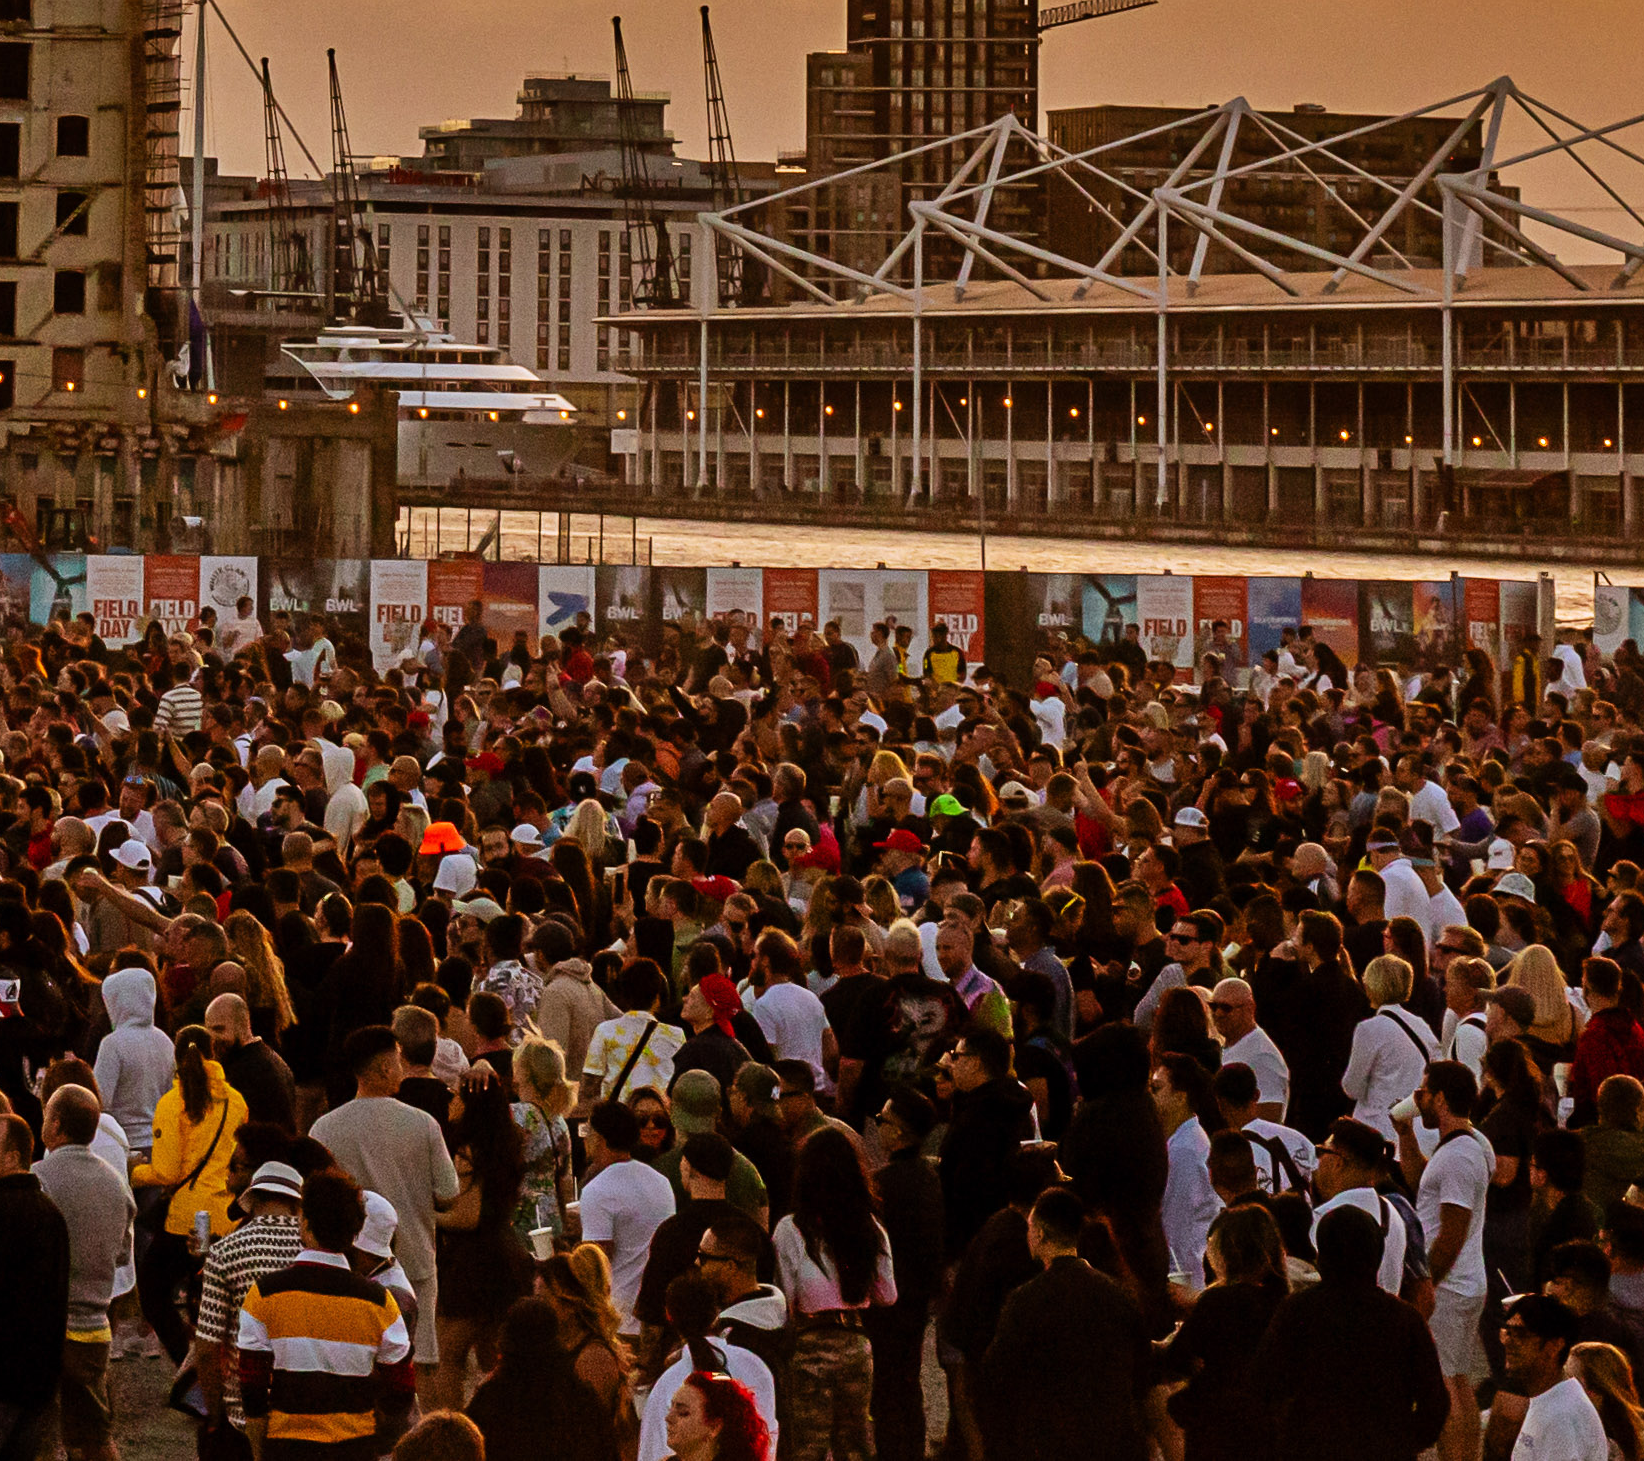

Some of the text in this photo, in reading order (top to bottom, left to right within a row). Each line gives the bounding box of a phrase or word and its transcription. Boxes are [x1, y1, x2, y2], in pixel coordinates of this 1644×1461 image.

[93, 599, 141, 619] FIELD
[325, 598, 359, 612] BWL
[376, 604, 421, 623] FIELD
[433, 606, 464, 623] FIEL
[99, 619, 132, 638] DAY
[1144, 619, 1187, 638] FIELD
